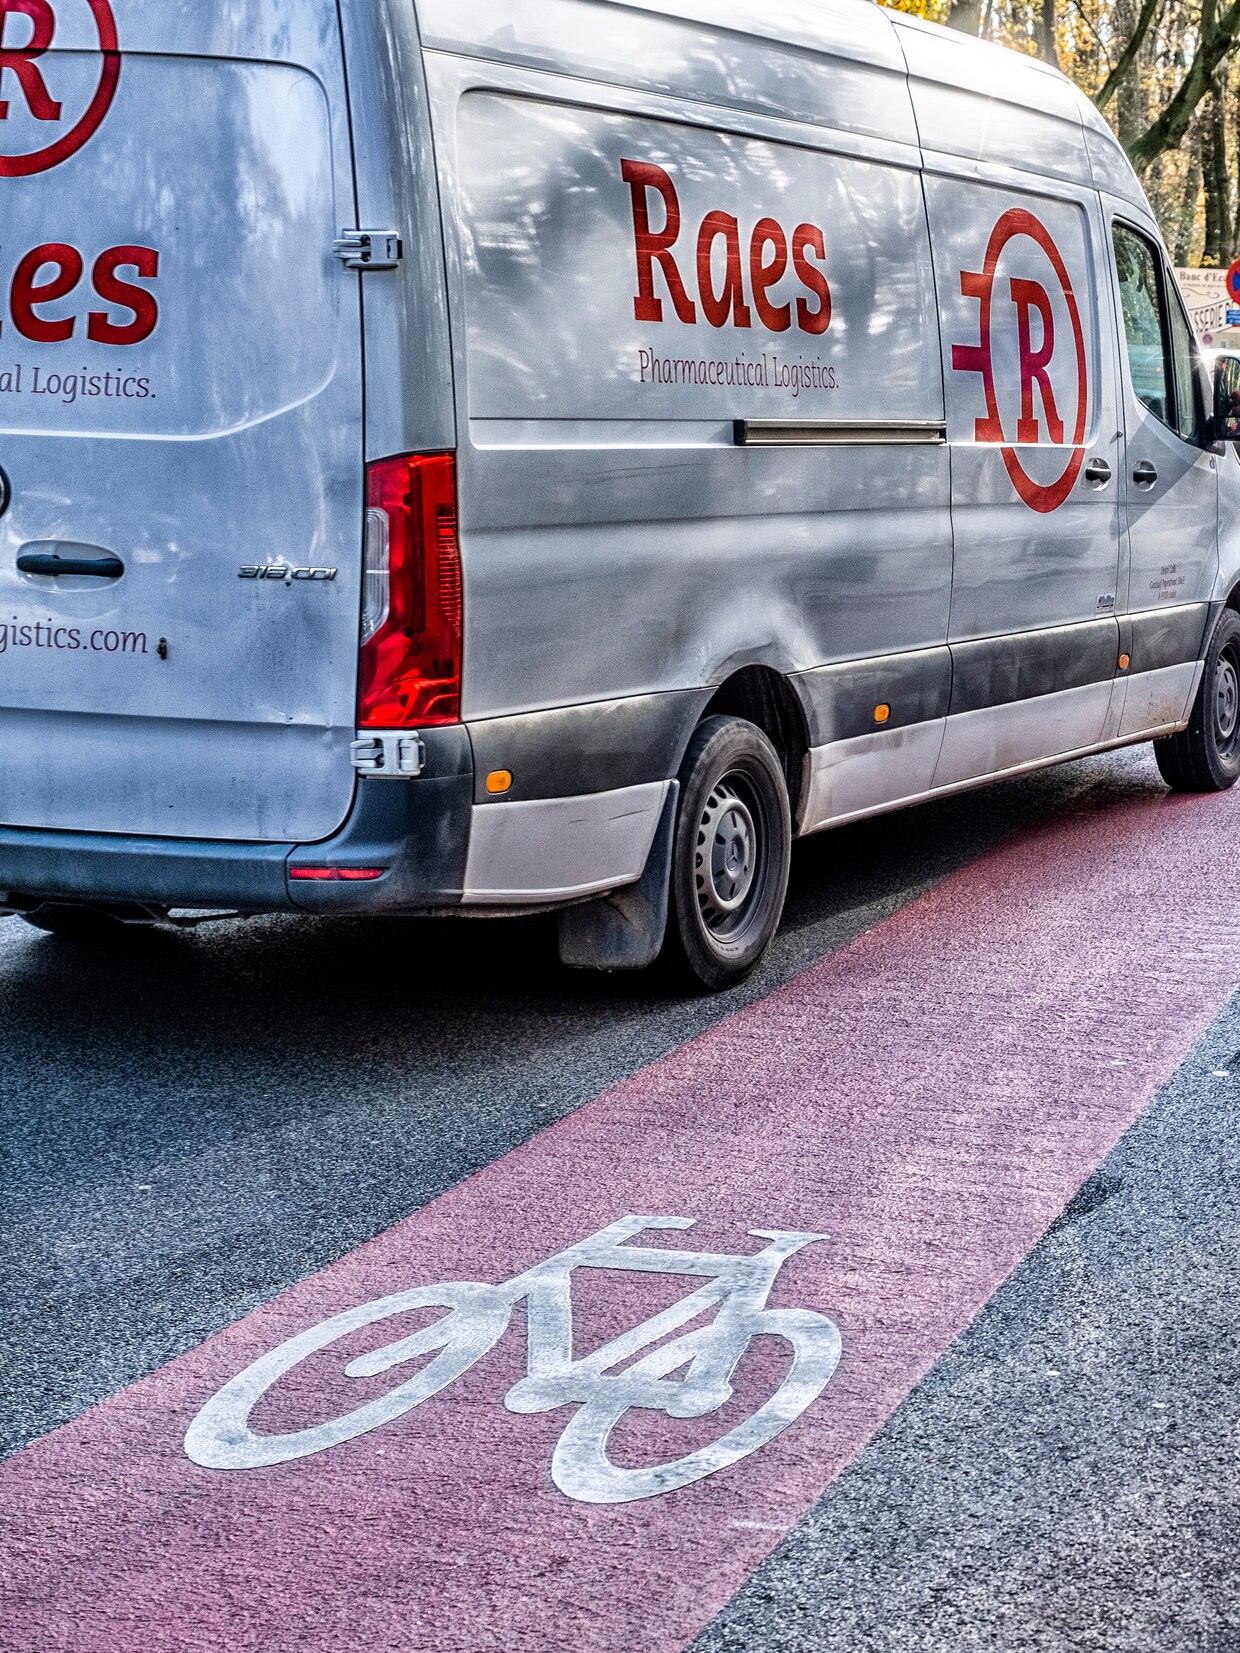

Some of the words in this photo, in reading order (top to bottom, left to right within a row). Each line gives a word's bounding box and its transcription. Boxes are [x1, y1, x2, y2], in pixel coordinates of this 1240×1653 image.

[621, 158, 832, 335] Raes
[1180, 271, 1201, 281] Banc
[31, 366, 156, 404] Logistics.
[638, 347, 769, 386] Pharmaceutical
[773, 356, 839, 398] Logistics.
[291, 566, 338, 581] CDI
